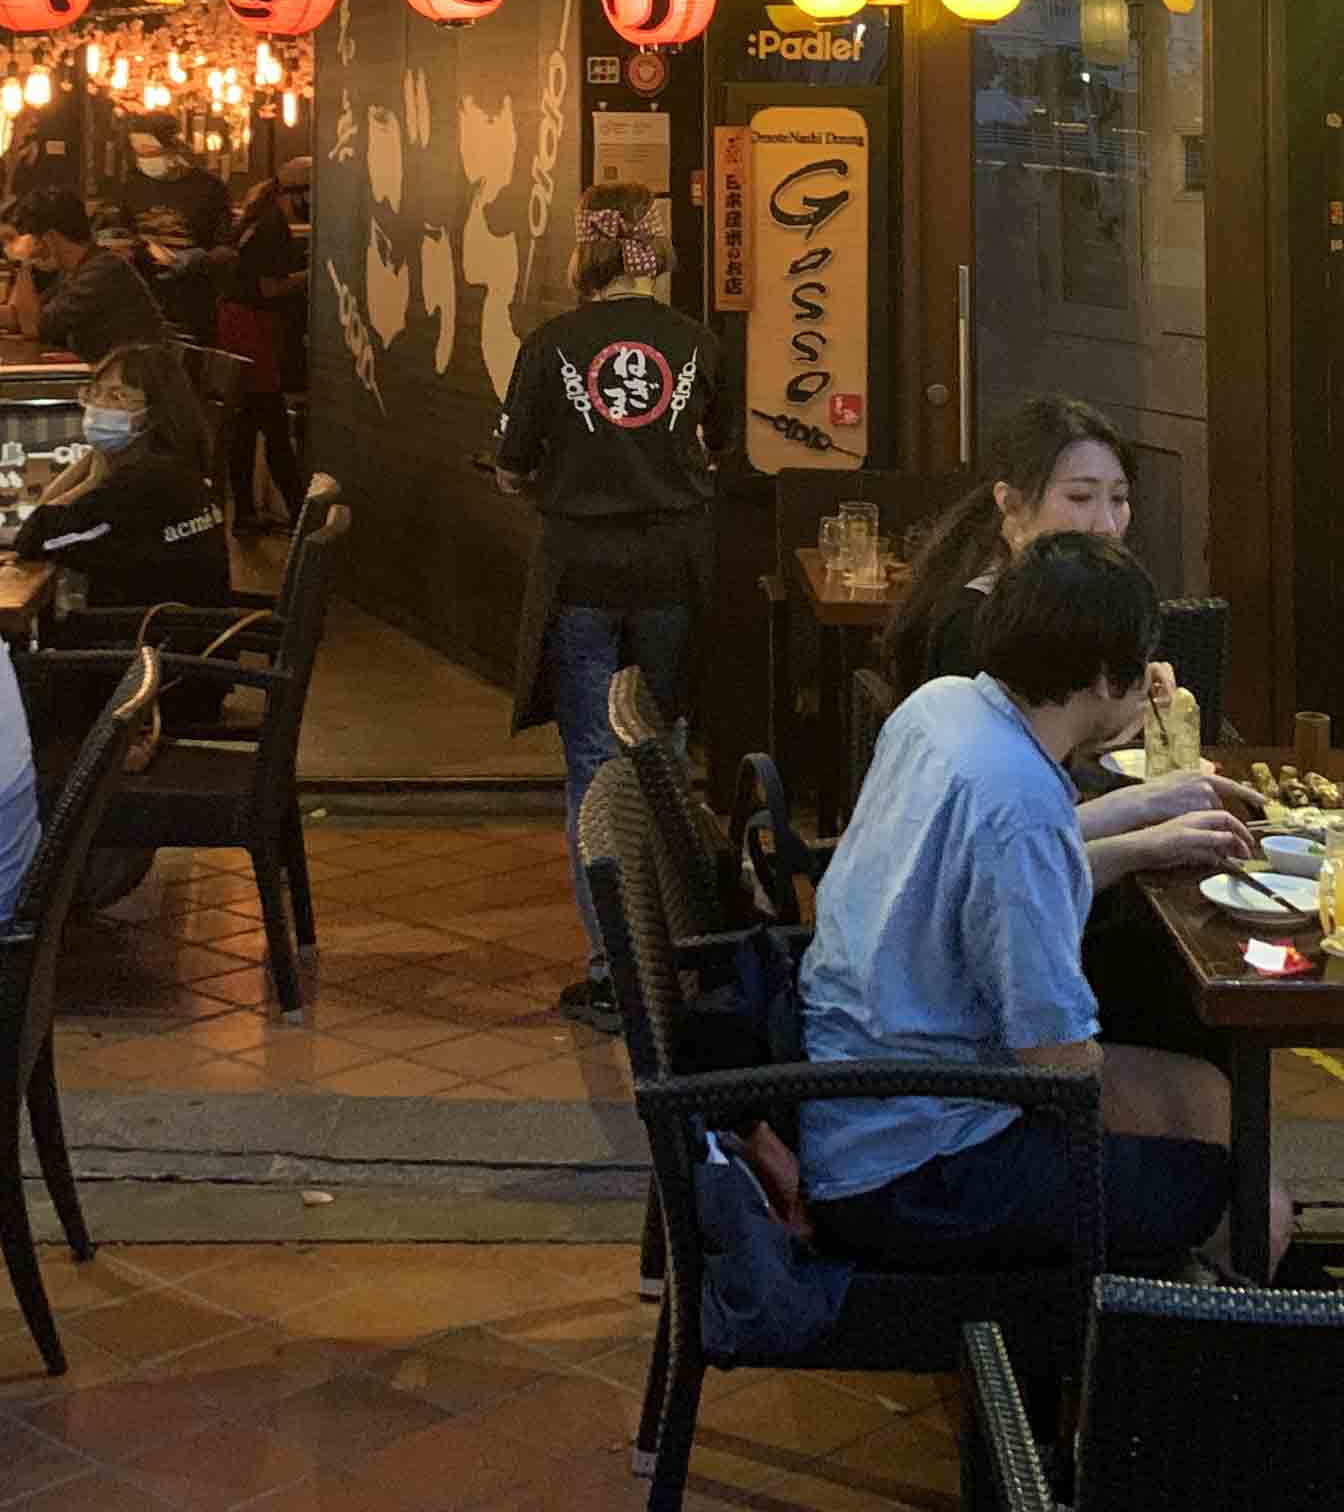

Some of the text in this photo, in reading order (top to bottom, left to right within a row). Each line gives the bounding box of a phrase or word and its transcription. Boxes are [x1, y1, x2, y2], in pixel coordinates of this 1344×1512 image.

[366, 67, 522, 405] ごっそ
[769, 158, 850, 406] Gosso
